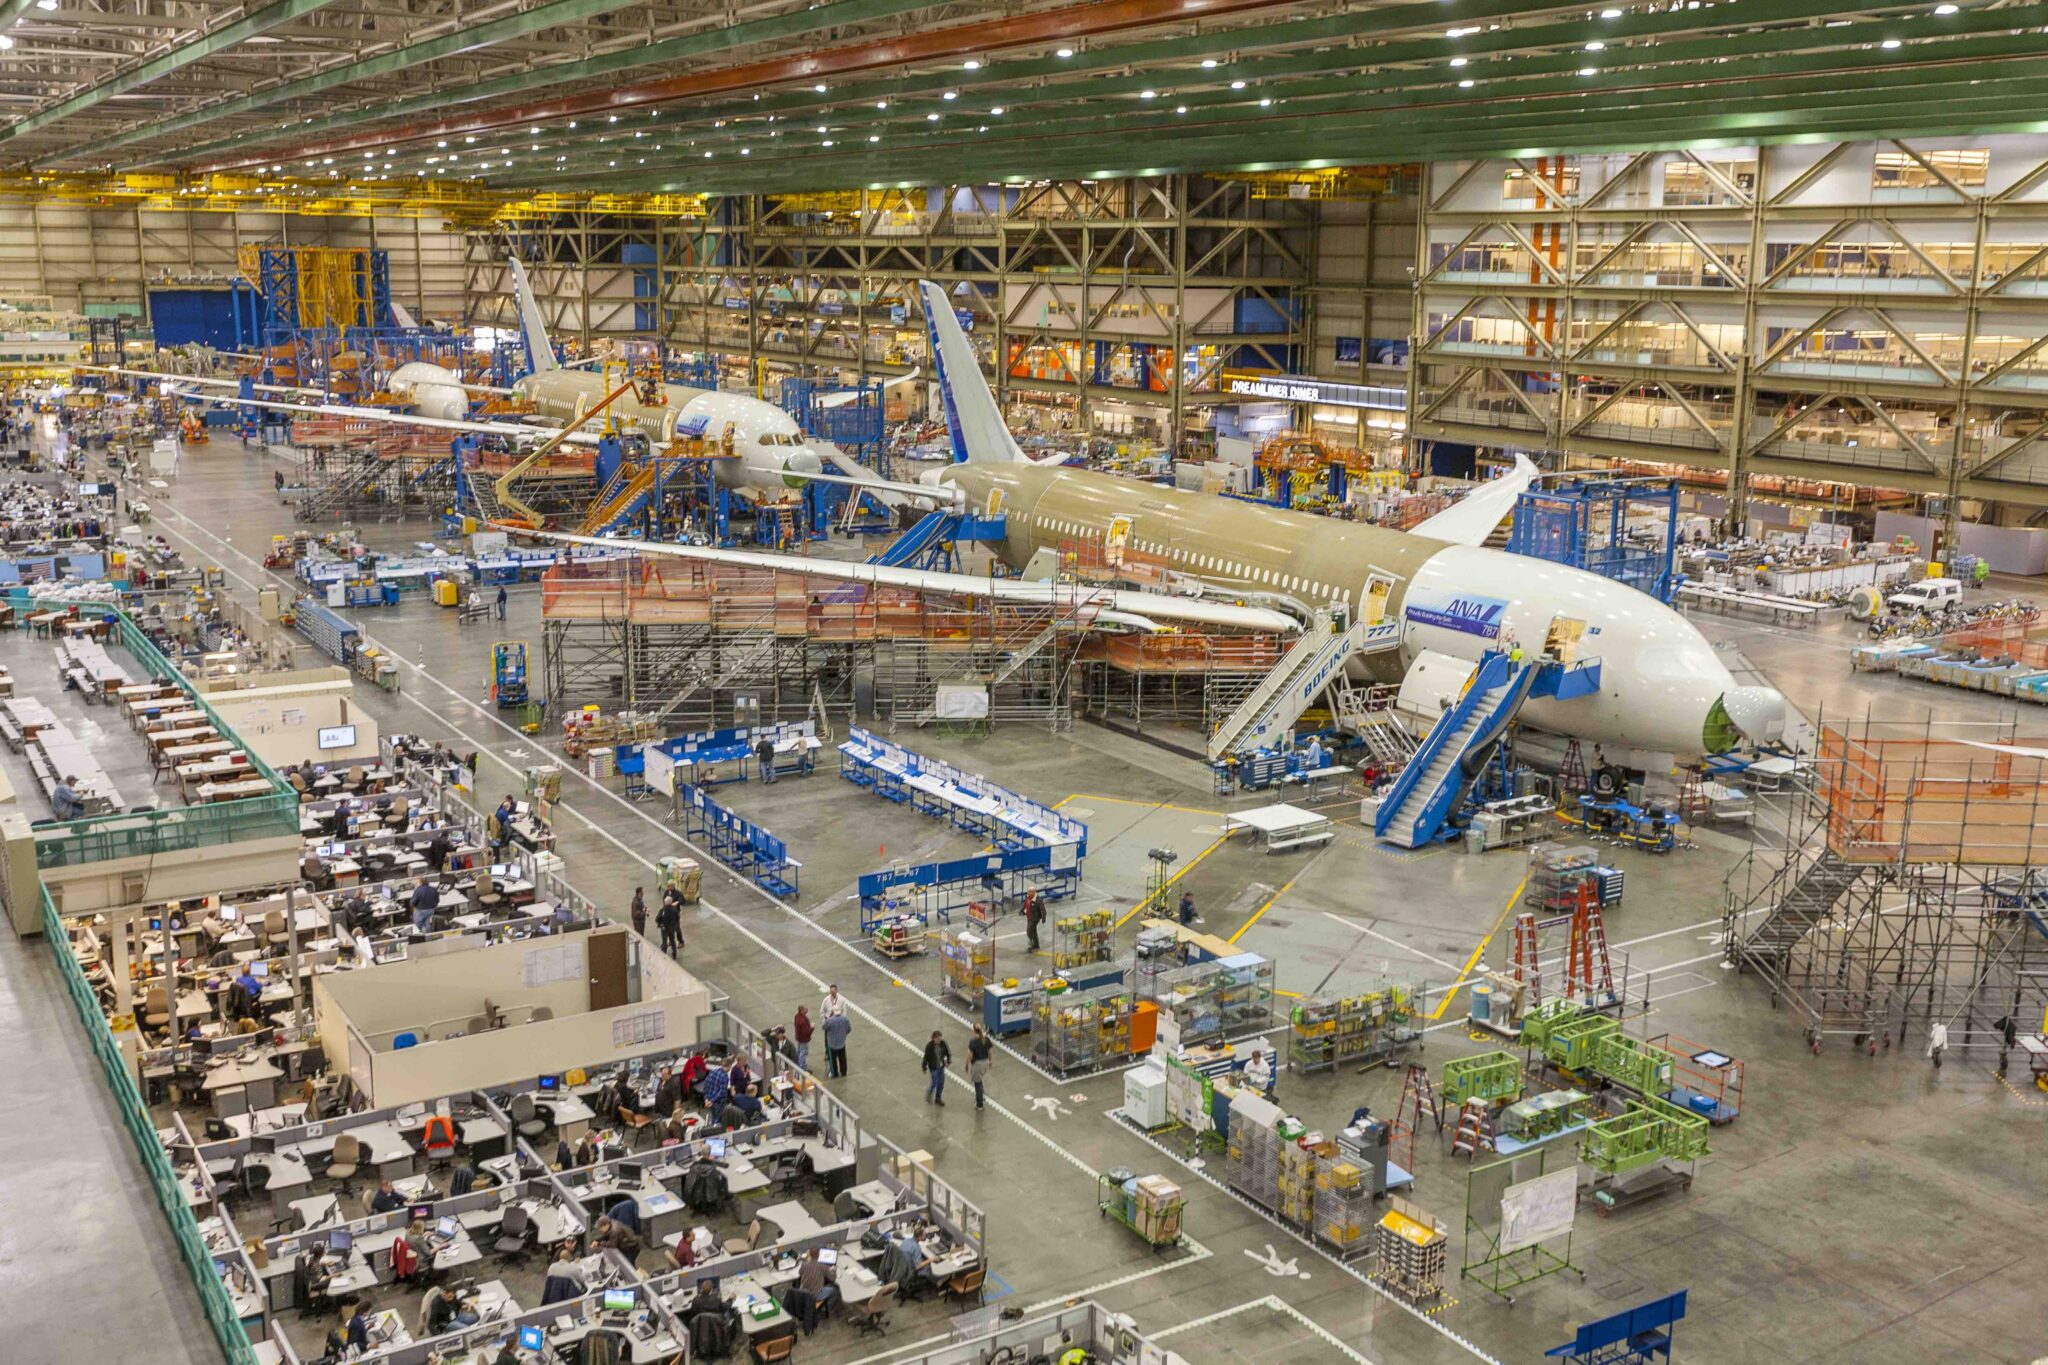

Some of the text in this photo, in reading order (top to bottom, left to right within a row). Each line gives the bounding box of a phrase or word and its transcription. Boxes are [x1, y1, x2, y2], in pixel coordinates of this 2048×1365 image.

[1231, 380, 1319, 401] DREAMLINER DINER
[1444, 598, 1484, 620] ANA
[1367, 624, 1396, 639] 777
[1482, 624, 1498, 638] 787
[1303, 638, 1351, 699] BOEING
[876, 873, 893, 883] 787
